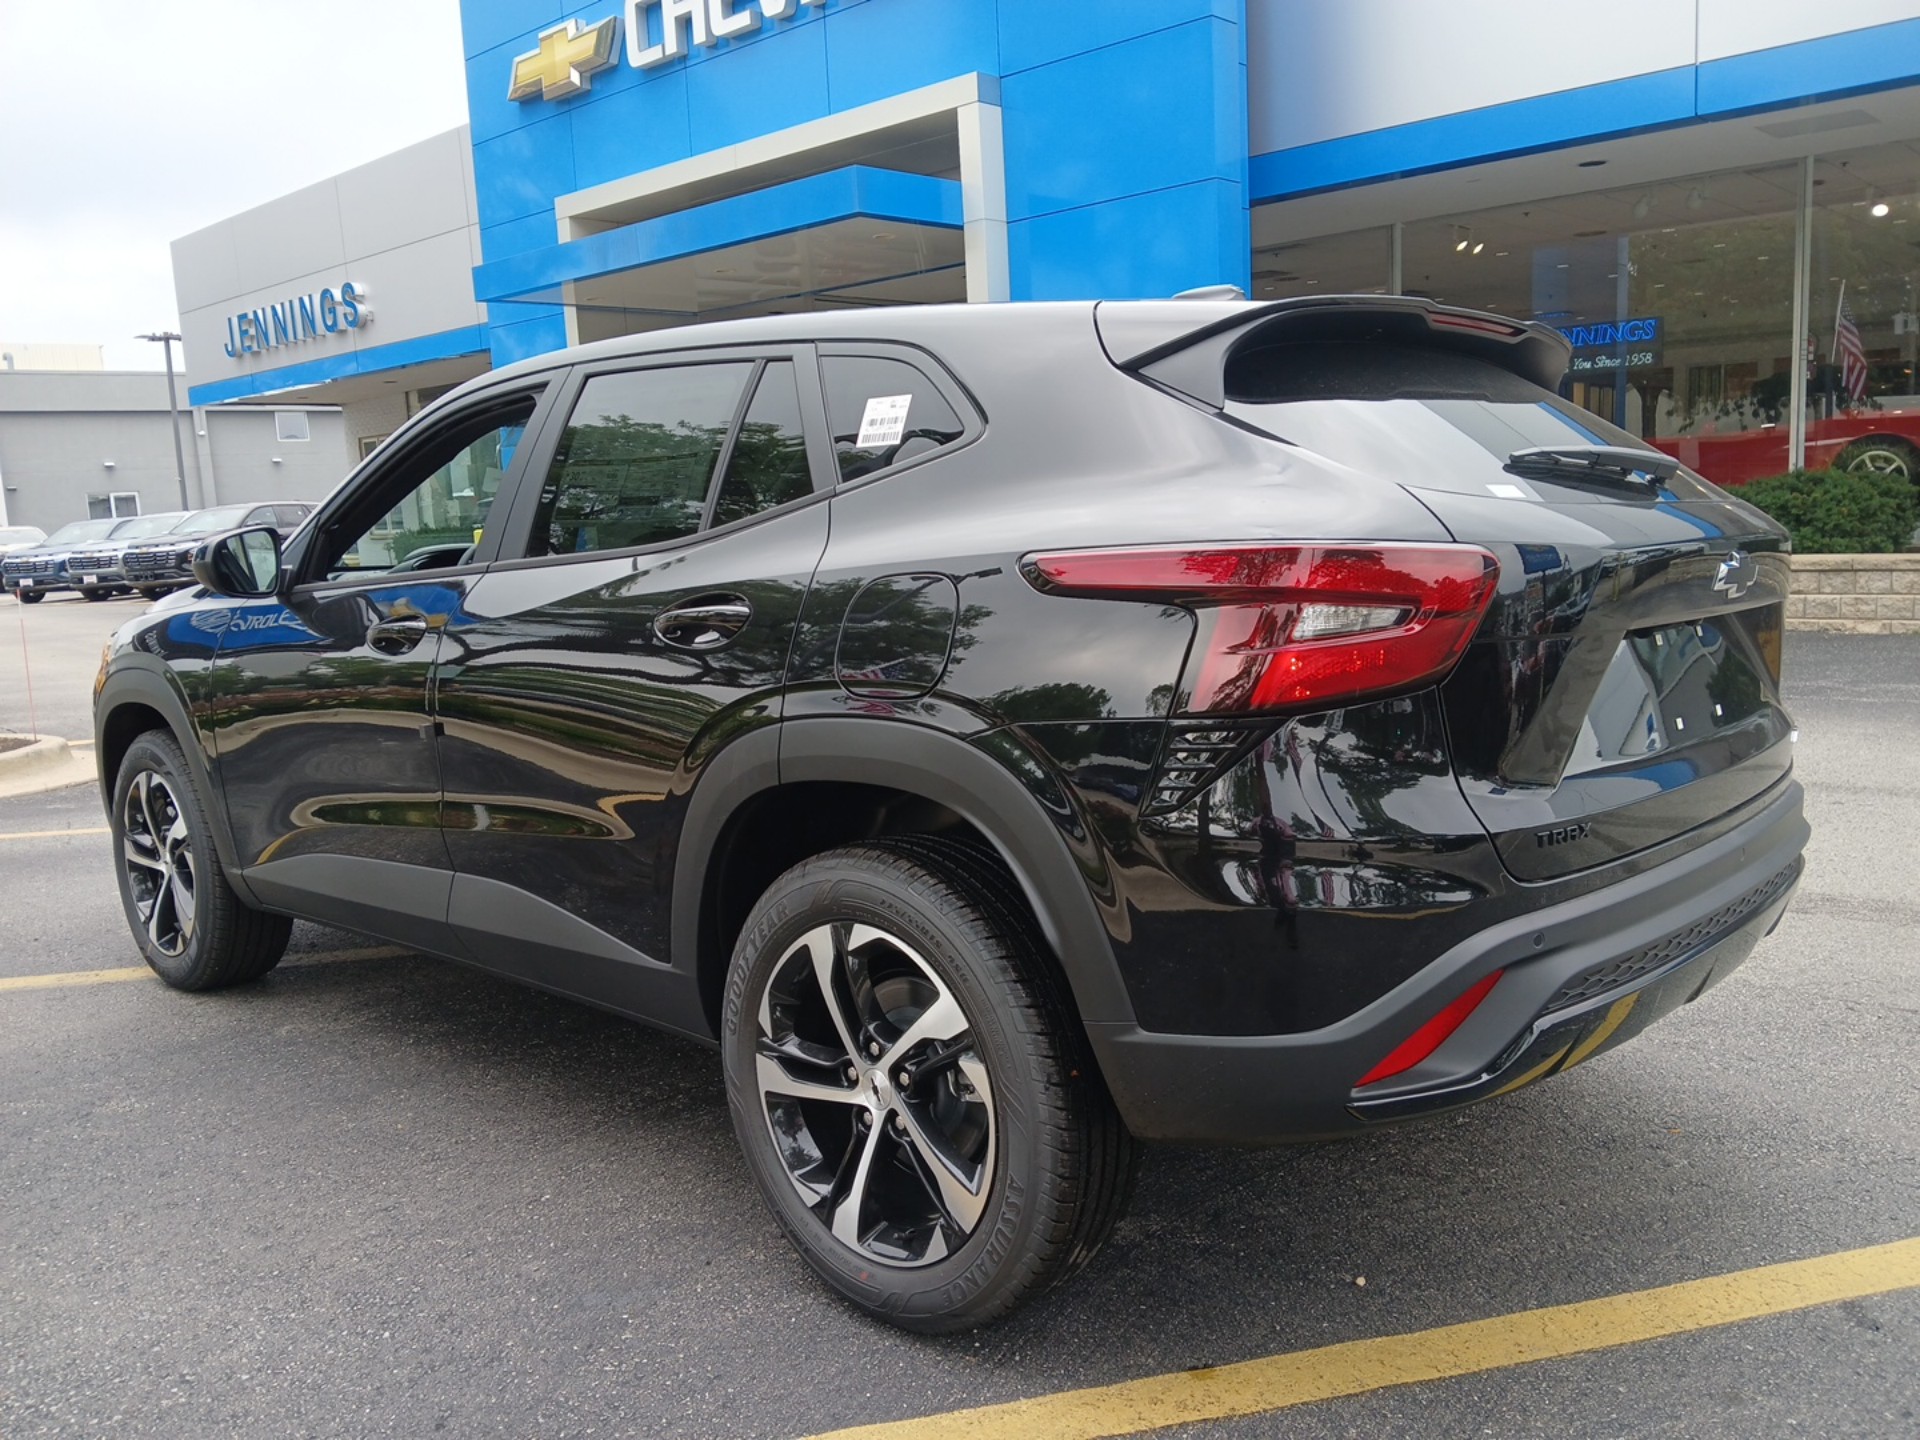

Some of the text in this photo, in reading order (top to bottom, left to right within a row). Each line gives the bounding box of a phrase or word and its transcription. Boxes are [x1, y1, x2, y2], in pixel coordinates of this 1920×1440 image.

[224, 282, 365, 358] JENNINGS
[1560, 319, 1656, 347] NNINGS
[1573, 357, 1592, 371] You
[1593, 355, 1622, 369] Since
[1625, 353, 1653, 366] 1958
[1535, 822, 1592, 848] TRAX
[726, 898, 789, 1036] GOODYEAR
[941, 1170, 1024, 1307] ASSURANCE
